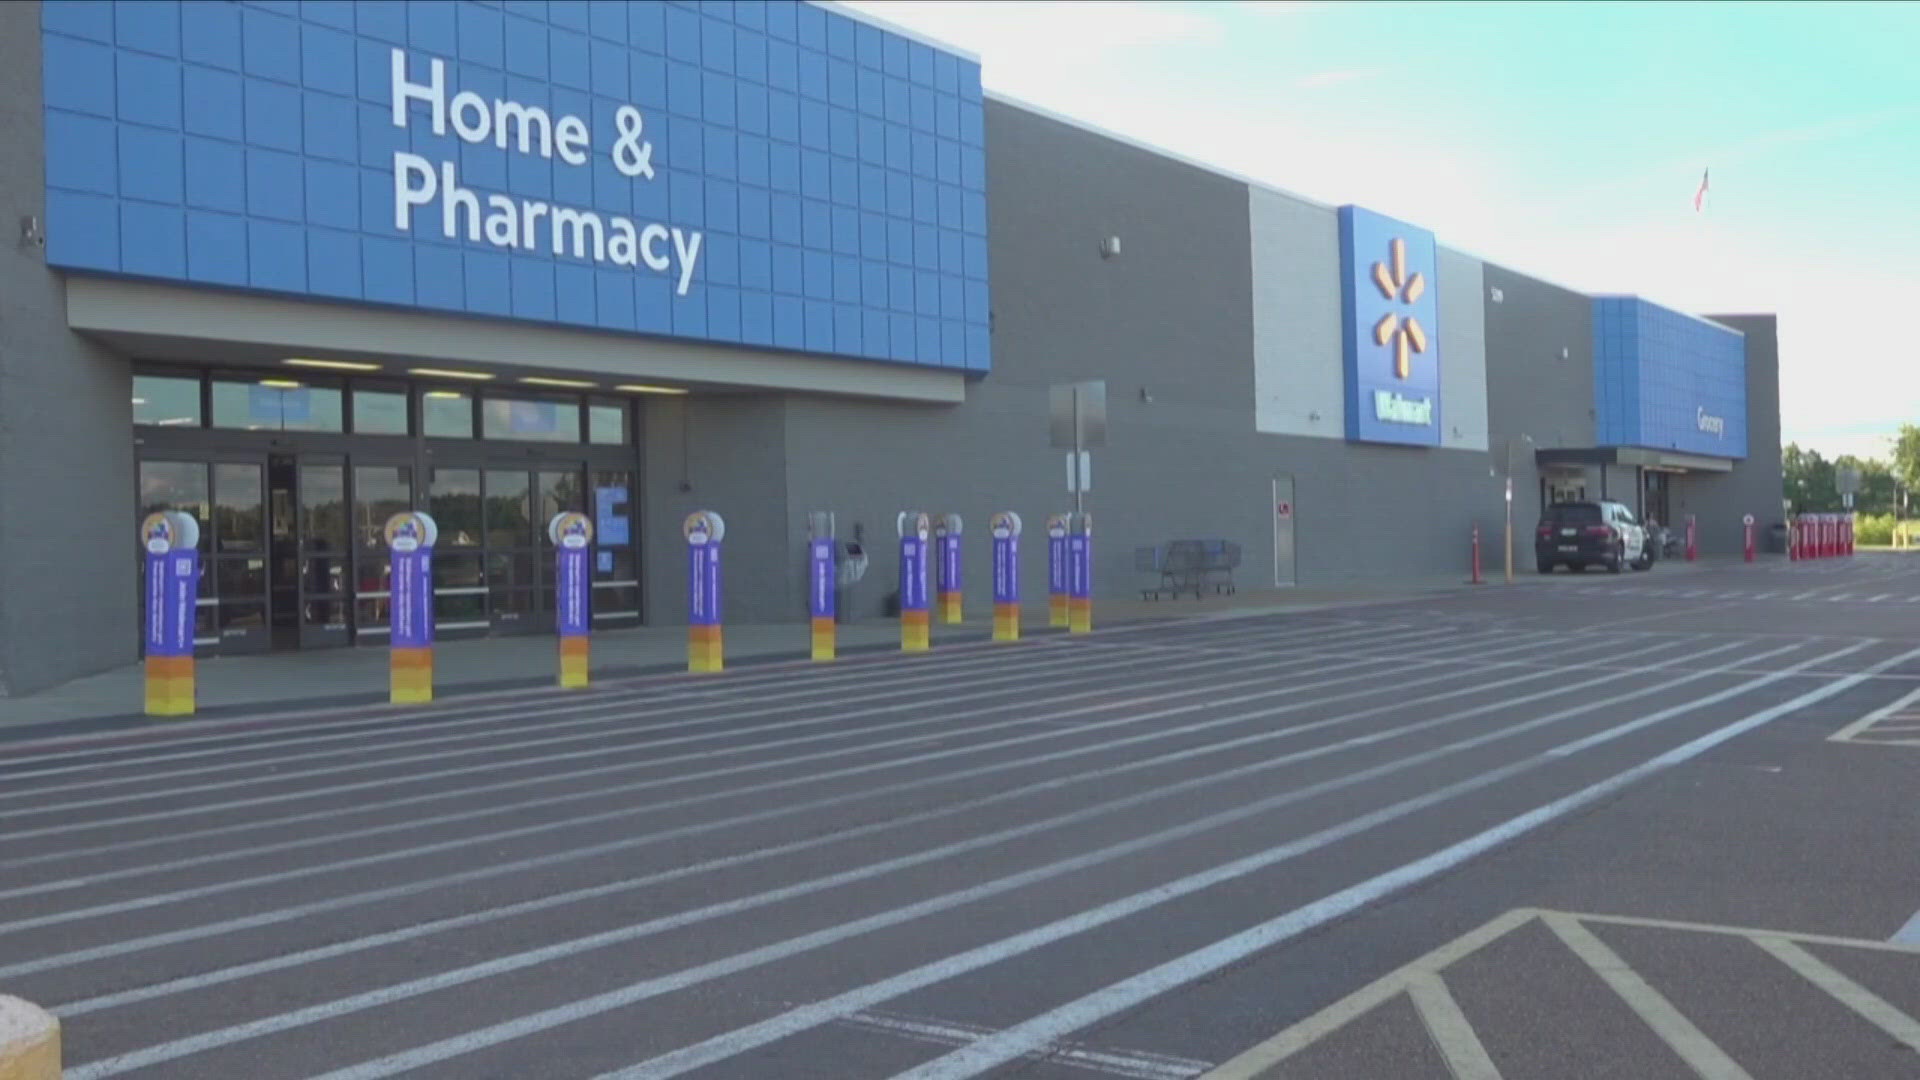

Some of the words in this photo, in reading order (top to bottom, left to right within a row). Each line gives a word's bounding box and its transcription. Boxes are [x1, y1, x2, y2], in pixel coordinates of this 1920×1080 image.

[392, 49, 589, 165] Home
[613, 106, 654, 179] &
[395, 152, 702, 295] Pharmacy
[1697, 405, 1724, 440] Grocery
